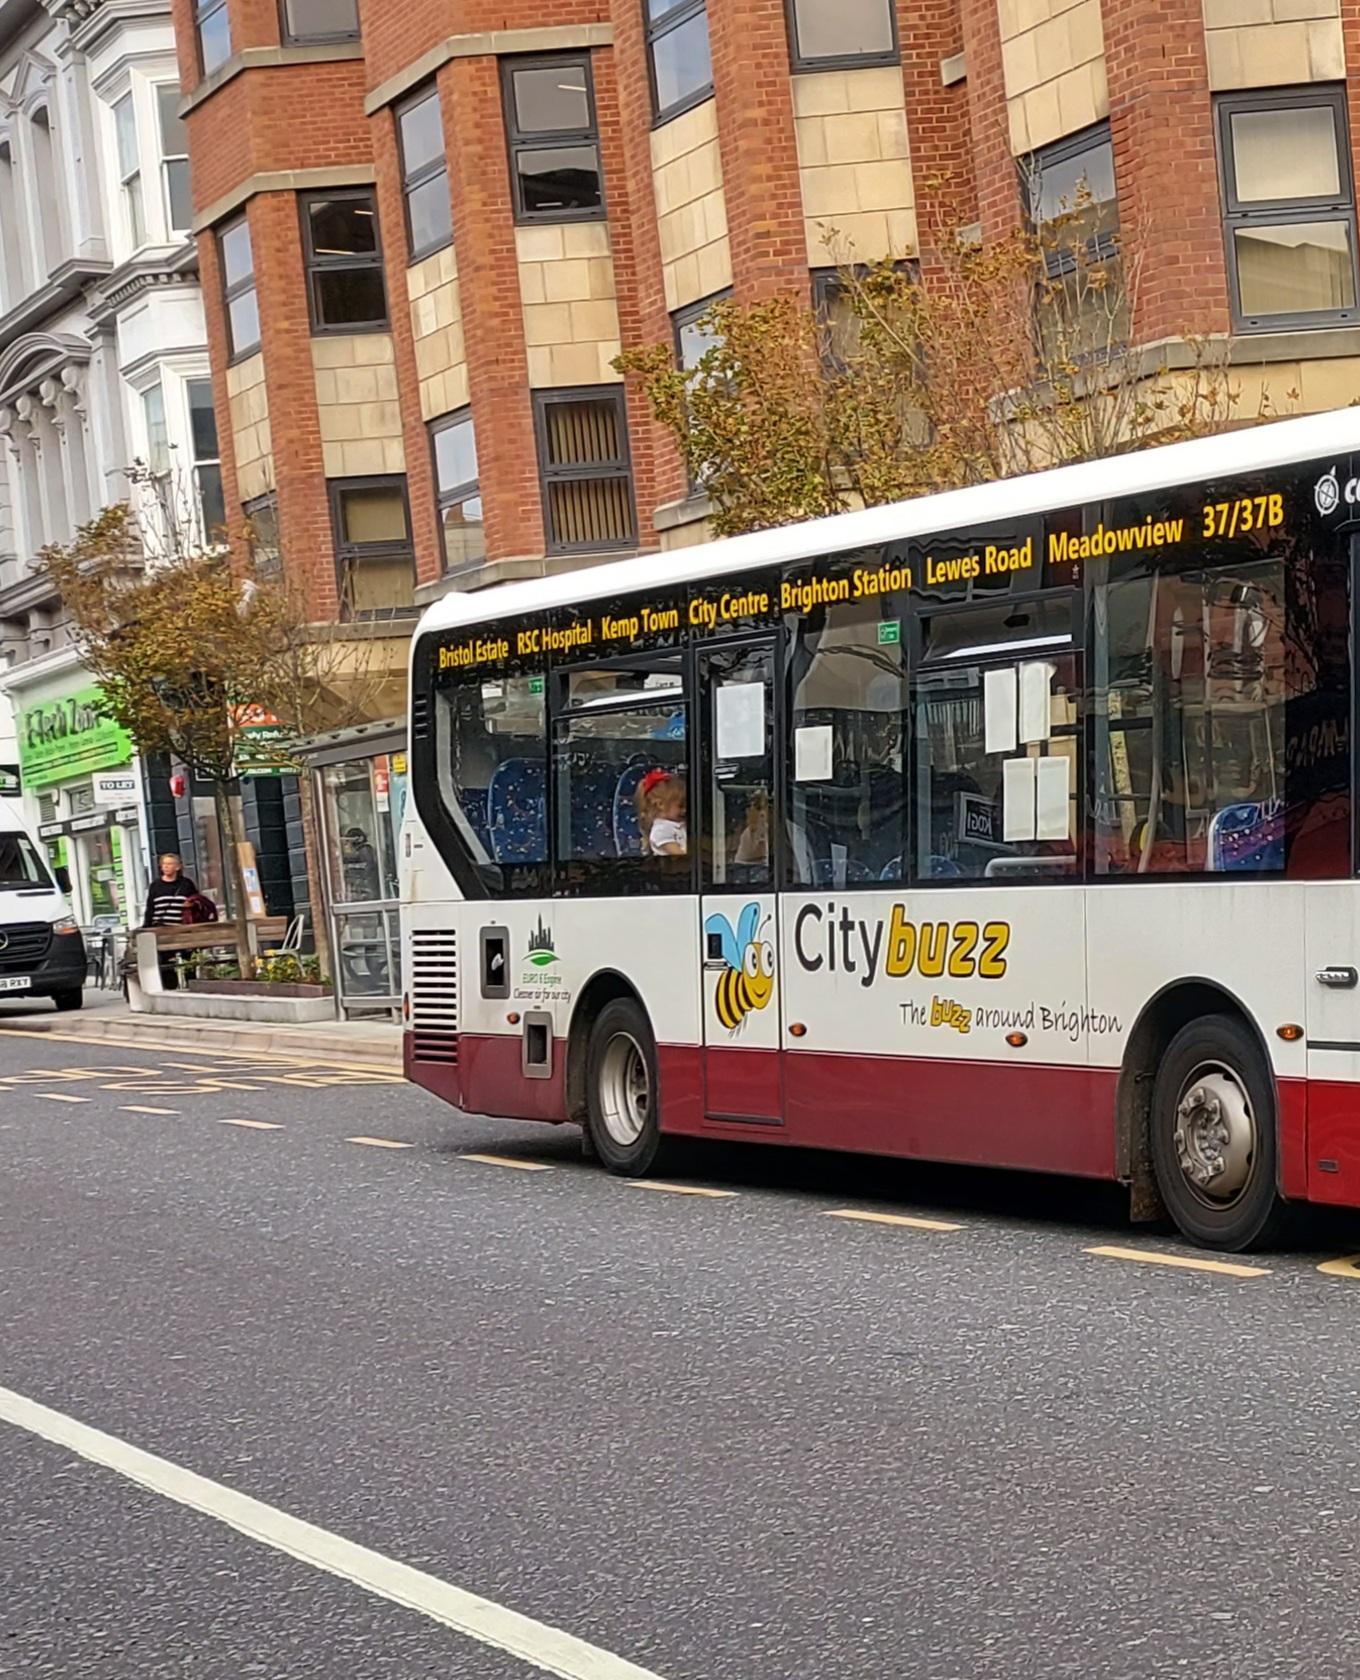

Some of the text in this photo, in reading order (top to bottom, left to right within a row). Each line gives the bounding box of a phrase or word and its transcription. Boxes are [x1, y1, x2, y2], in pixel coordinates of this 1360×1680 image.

[439, 493, 1284, 669] Bristol Estate RSC Hospital Kemp Town City Centre Brighton Station Lewes Road Meadowview 37/37B
[101, 780, 134, 790] TO LET
[900, 995, 1123, 1042] The buzz around Brighton
